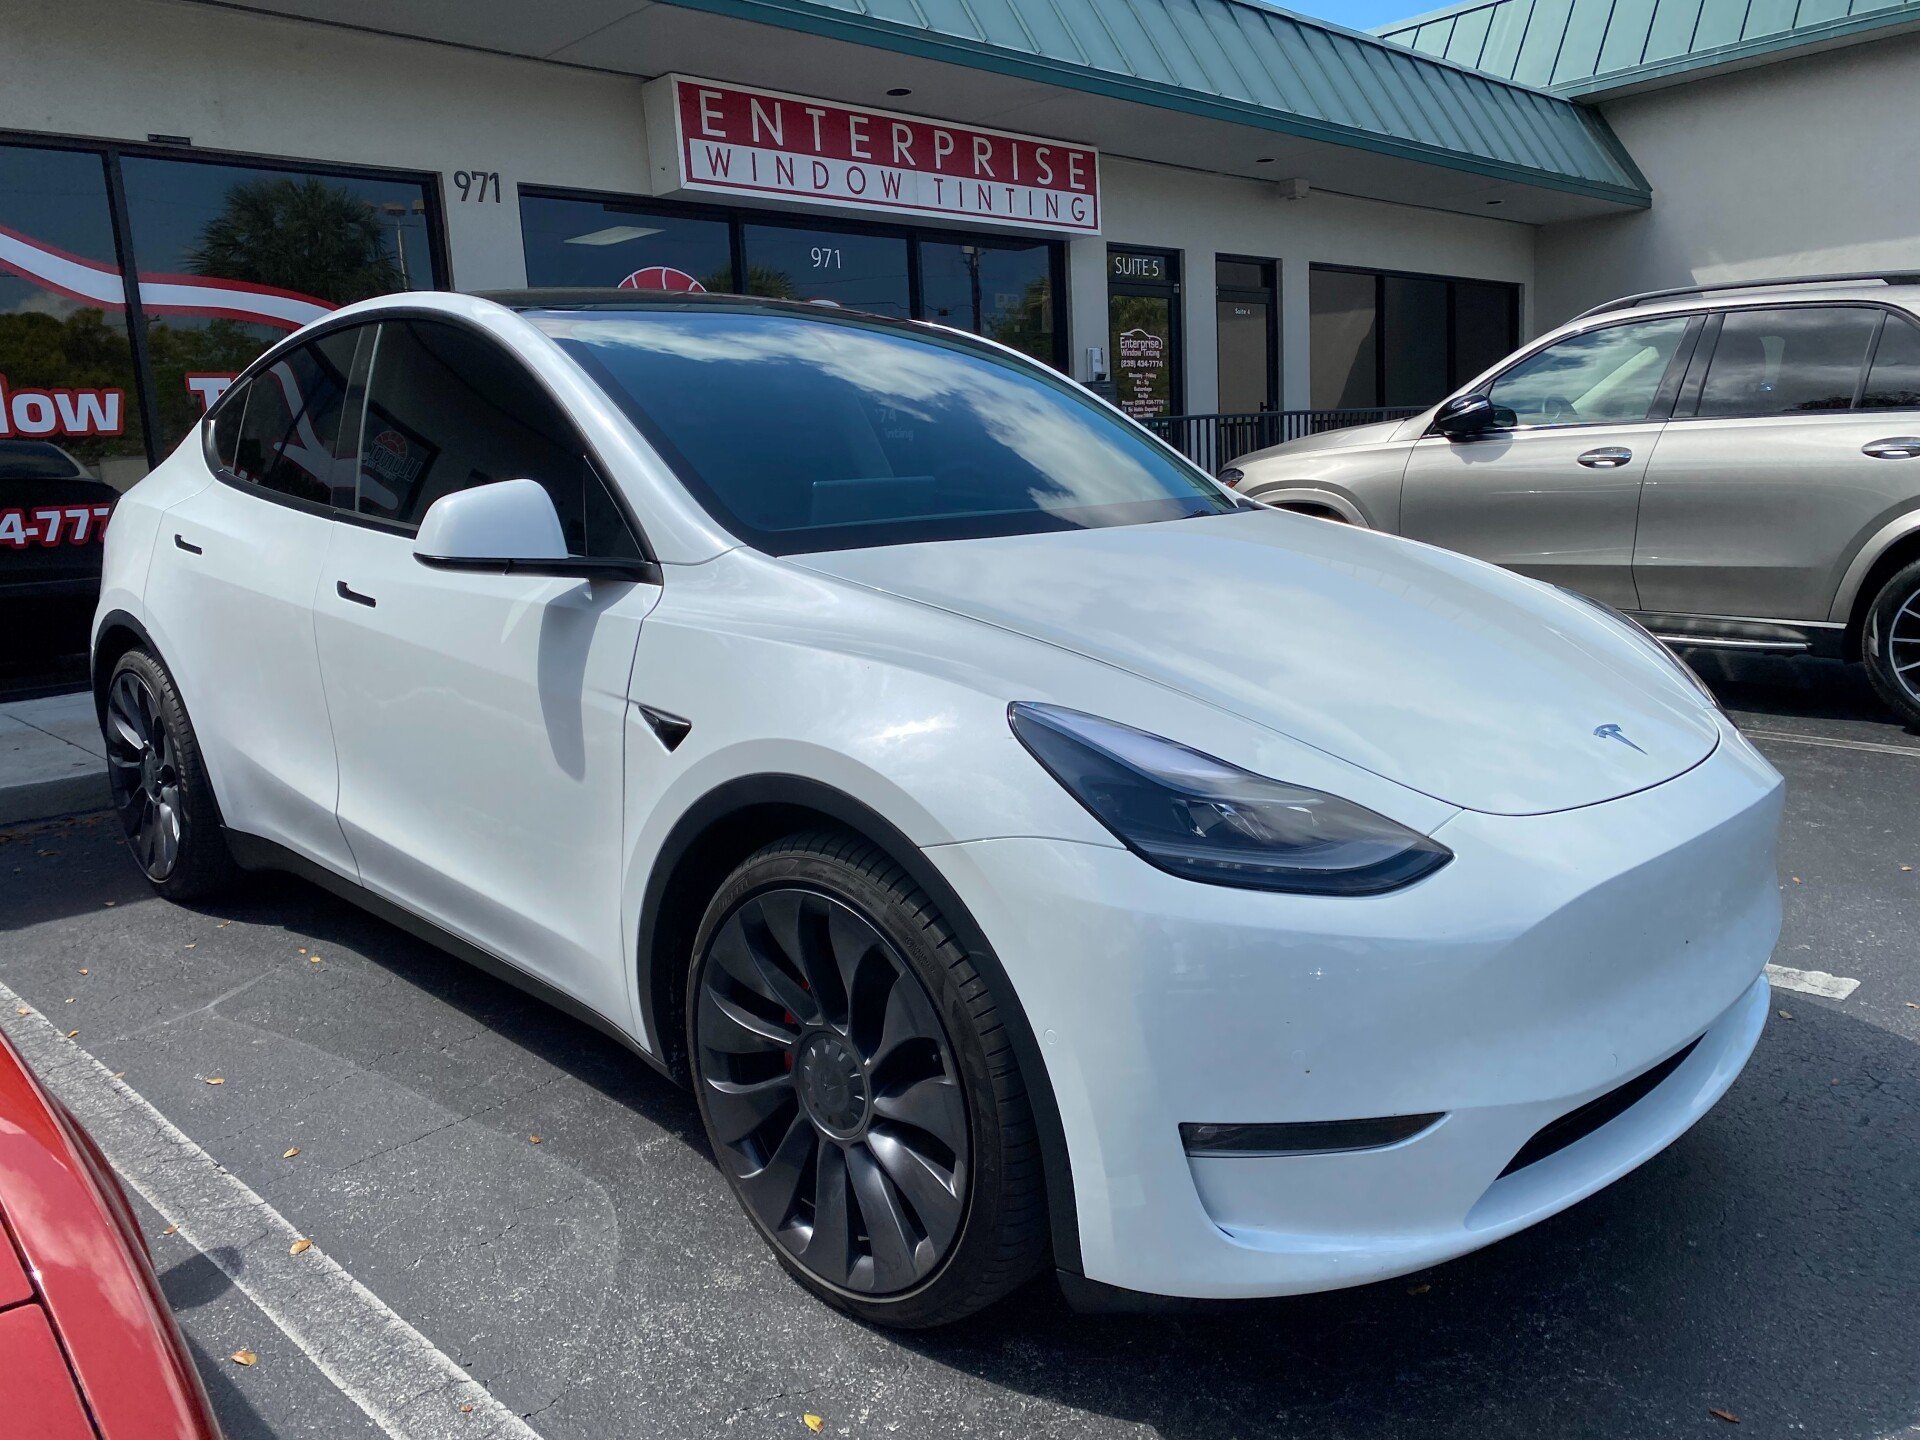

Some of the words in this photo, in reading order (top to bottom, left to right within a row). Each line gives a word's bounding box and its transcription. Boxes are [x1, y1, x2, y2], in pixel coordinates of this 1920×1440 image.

[699, 89, 1086, 191] ENTERPRISE
[453, 170, 501, 203] 971
[706, 145, 902, 200] WINDOW
[933, 177, 1086, 222] TINTING
[810, 247, 841, 269] 971
[1115, 257, 1149, 276] SUITE
[1152, 260, 1159, 277] 5
[1120, 336, 1160, 351] Enterprise
[1120, 348, 1142, 357] Window
[1143, 348, 1160, 359] Tinting
[1137, 360, 1163, 368] 434-7774
